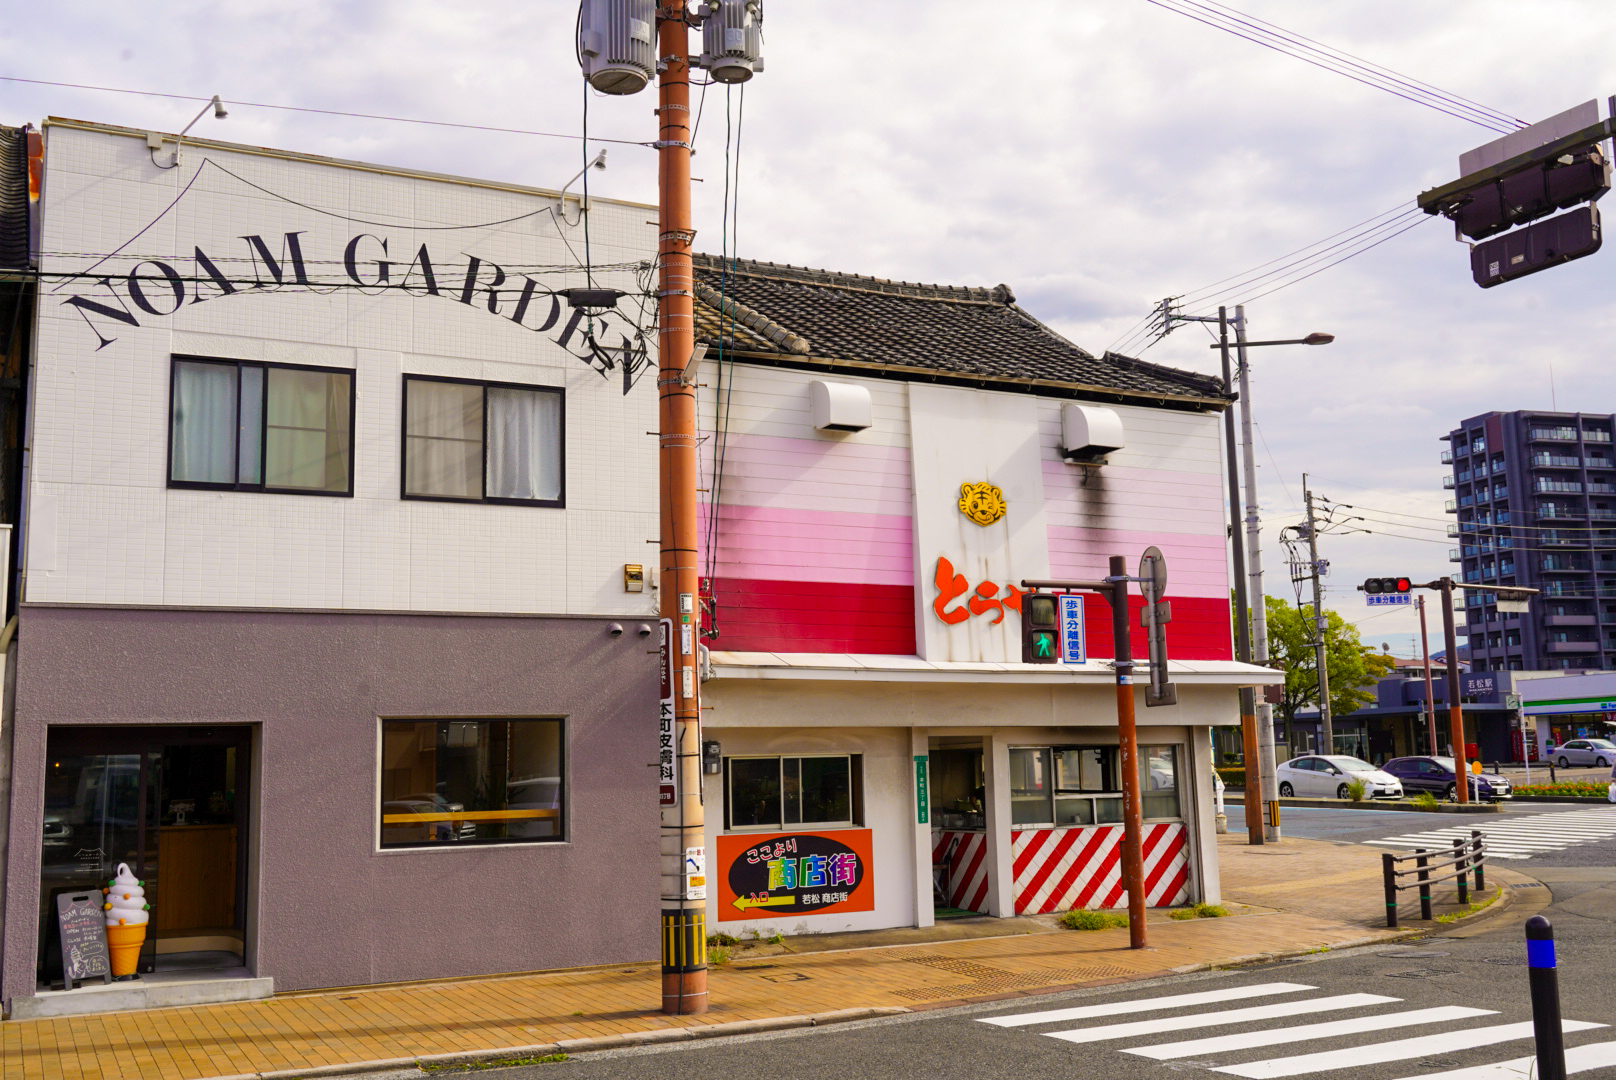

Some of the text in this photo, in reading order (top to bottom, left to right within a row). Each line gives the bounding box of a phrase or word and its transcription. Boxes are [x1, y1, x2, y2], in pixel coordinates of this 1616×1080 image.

[61, 231, 657, 396] NOAM GARDEN
[1368, 596, 1409, 605] 歩車分離信号
[1065, 599, 1081, 661] 歩車分離信号
[1467, 678, 1494, 689] 若松駅
[660, 702, 674, 781] 本町皮膚科
[747, 838, 797, 864] ここより
[767, 853, 856, 891] 商店街
[749, 891, 769, 903] 入口
[60, 909, 78, 922] NOAM
